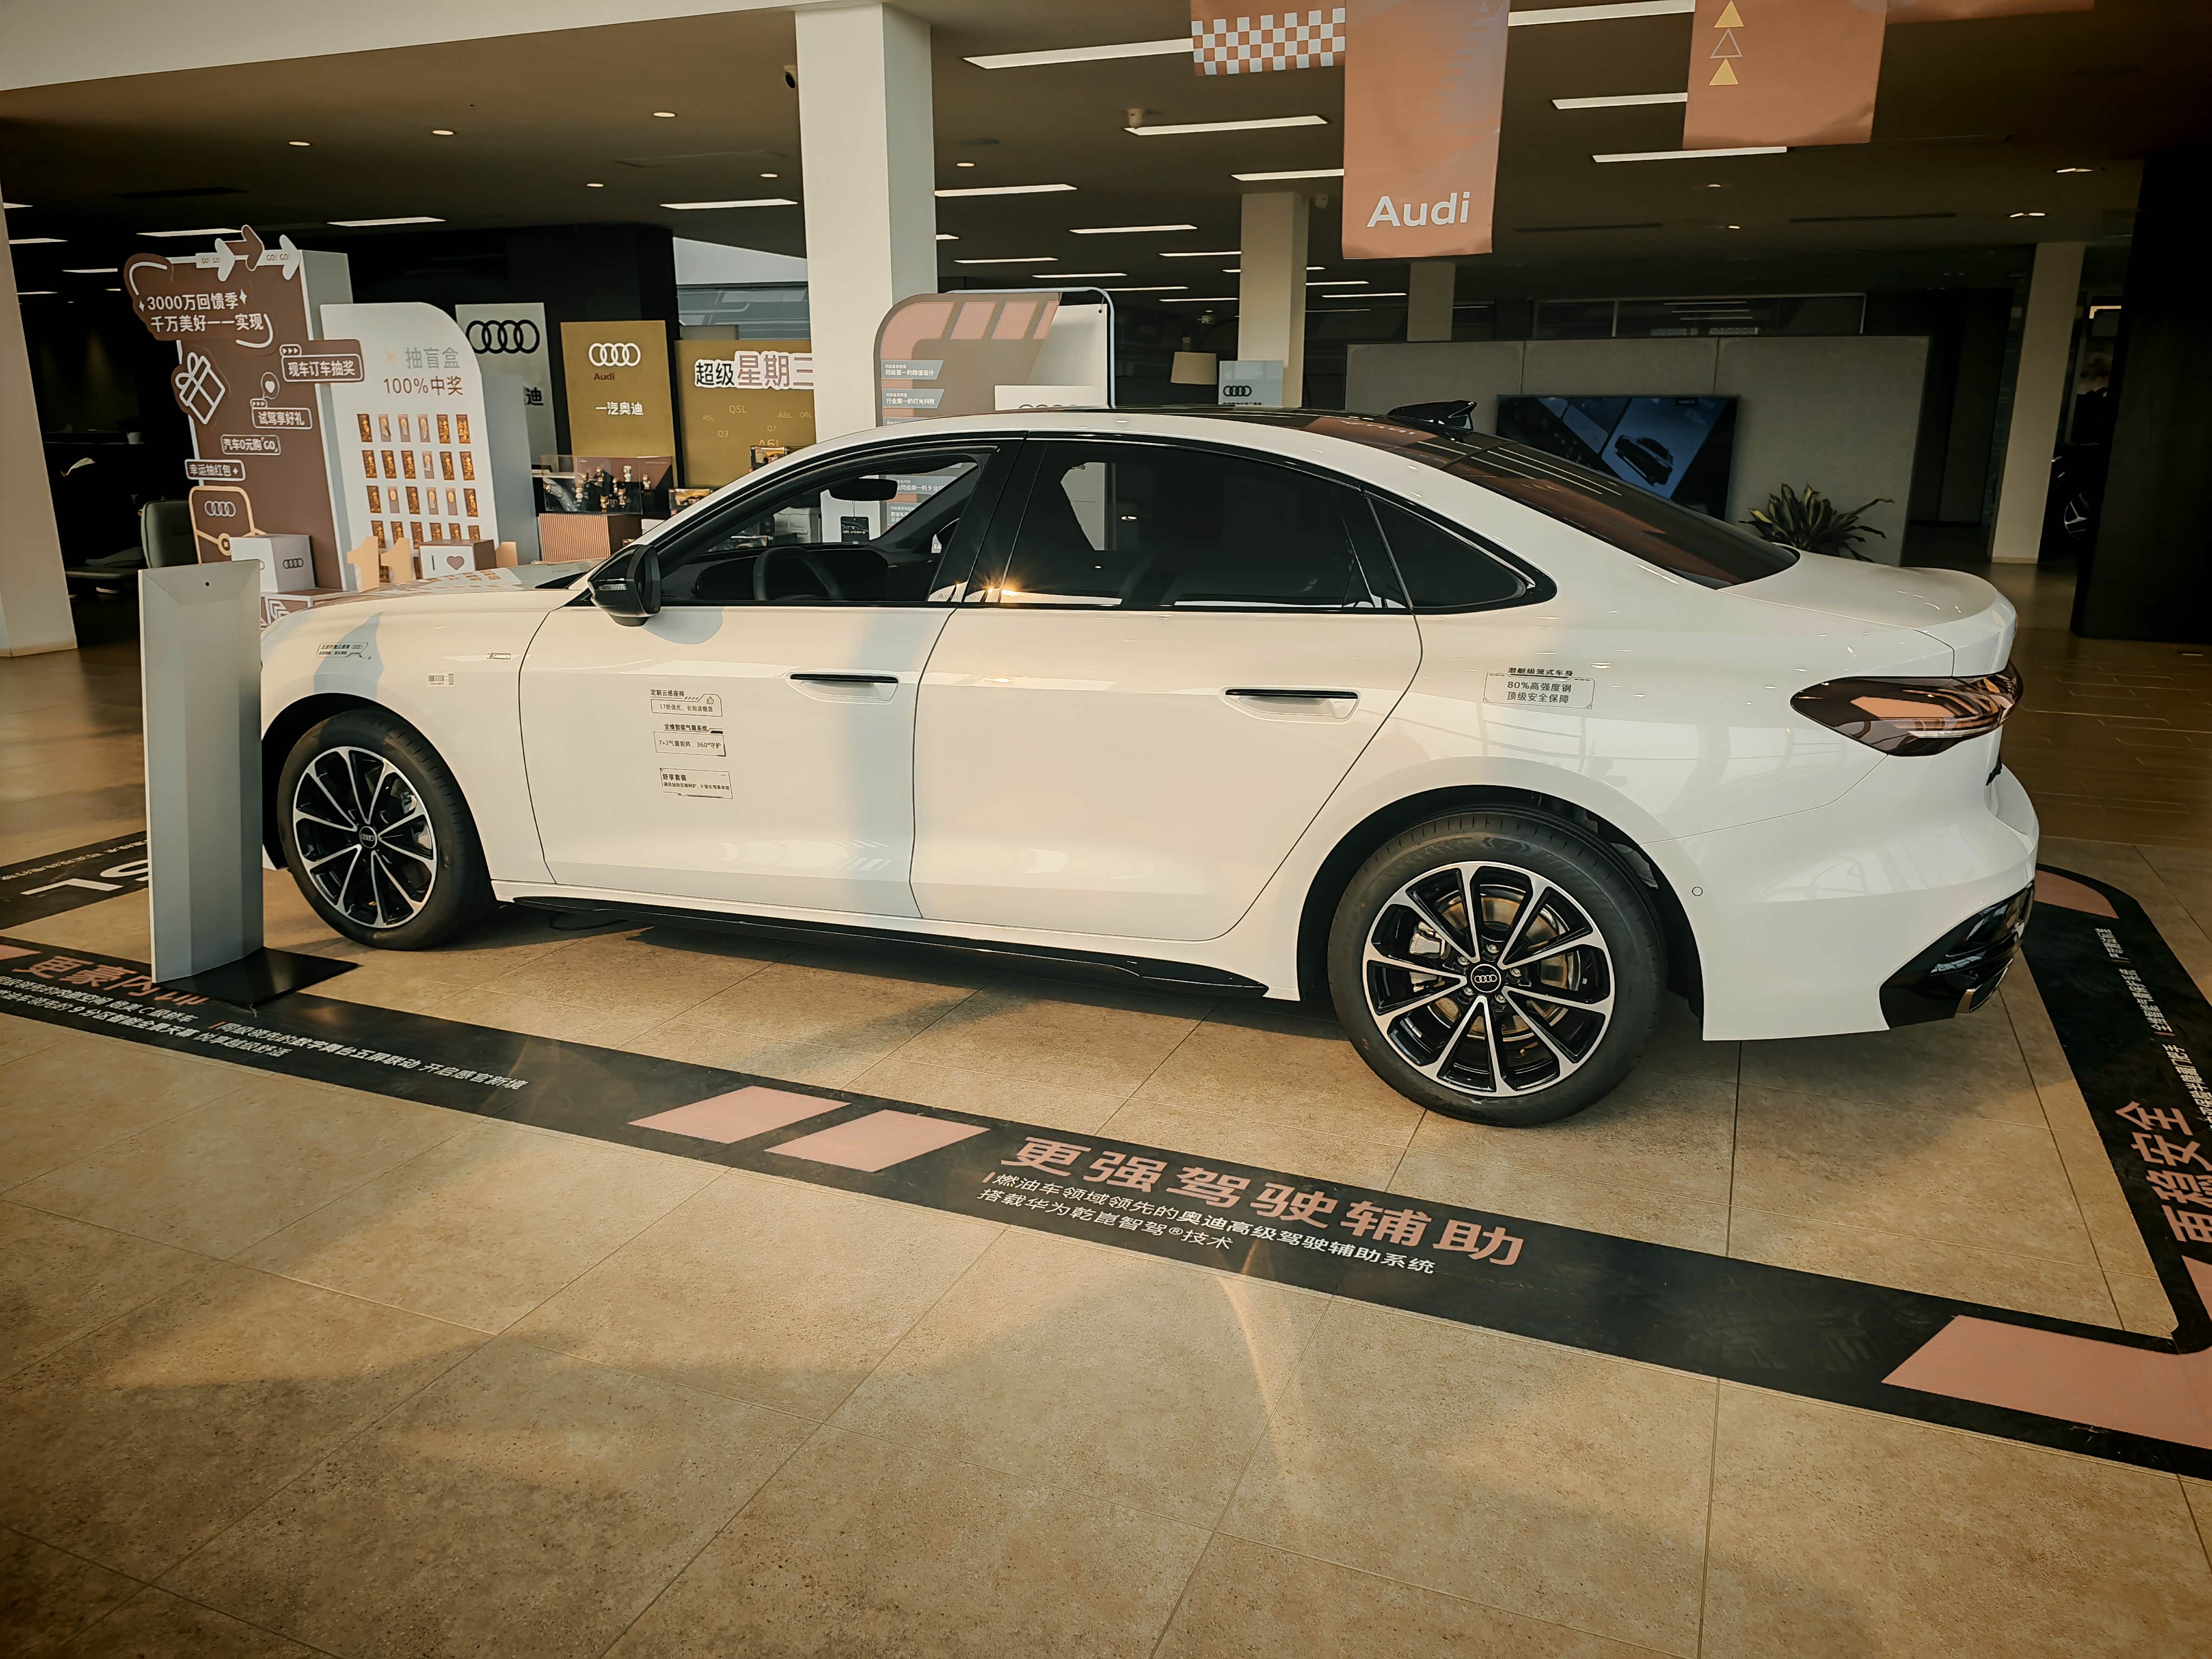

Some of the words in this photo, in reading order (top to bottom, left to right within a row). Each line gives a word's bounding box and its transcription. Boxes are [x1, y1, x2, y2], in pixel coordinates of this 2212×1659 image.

[1367, 191, 1471, 227] Audi
[147, 292, 239, 311] 3000万回馈季
[406, 347, 460, 369] 抽盲盒
[287, 360, 356, 377] 现车订车抽奖
[696, 354, 814, 387] 超级星期三
[383, 376, 463, 396] 100%中奖
[524, 387, 544, 406] 迪
[595, 401, 644, 415] 一汽奥迪
[729, 406, 747, 414] Q5L
[258, 412, 305, 426] 试驾享好礼
[1507, 667, 1574, 677] 潜艇级笼式车身
[651, 689, 684, 697] 定制云感座椅
[1507, 681, 1572, 693] 80%高强度钢
[1507, 691, 1569, 704] 顶级安全保障
[664, 724, 708, 732] 全维智能气囊系统
[662, 773, 687, 781] 舒享套装
[2119, 968, 2172, 1034] 全维智能气囊保护系统
[1001, 1137, 1525, 1265] 更强驾驶辅助
[992, 1172, 1437, 1275] 燃油车领域领先的奥迪高级驾驶辅助系统
